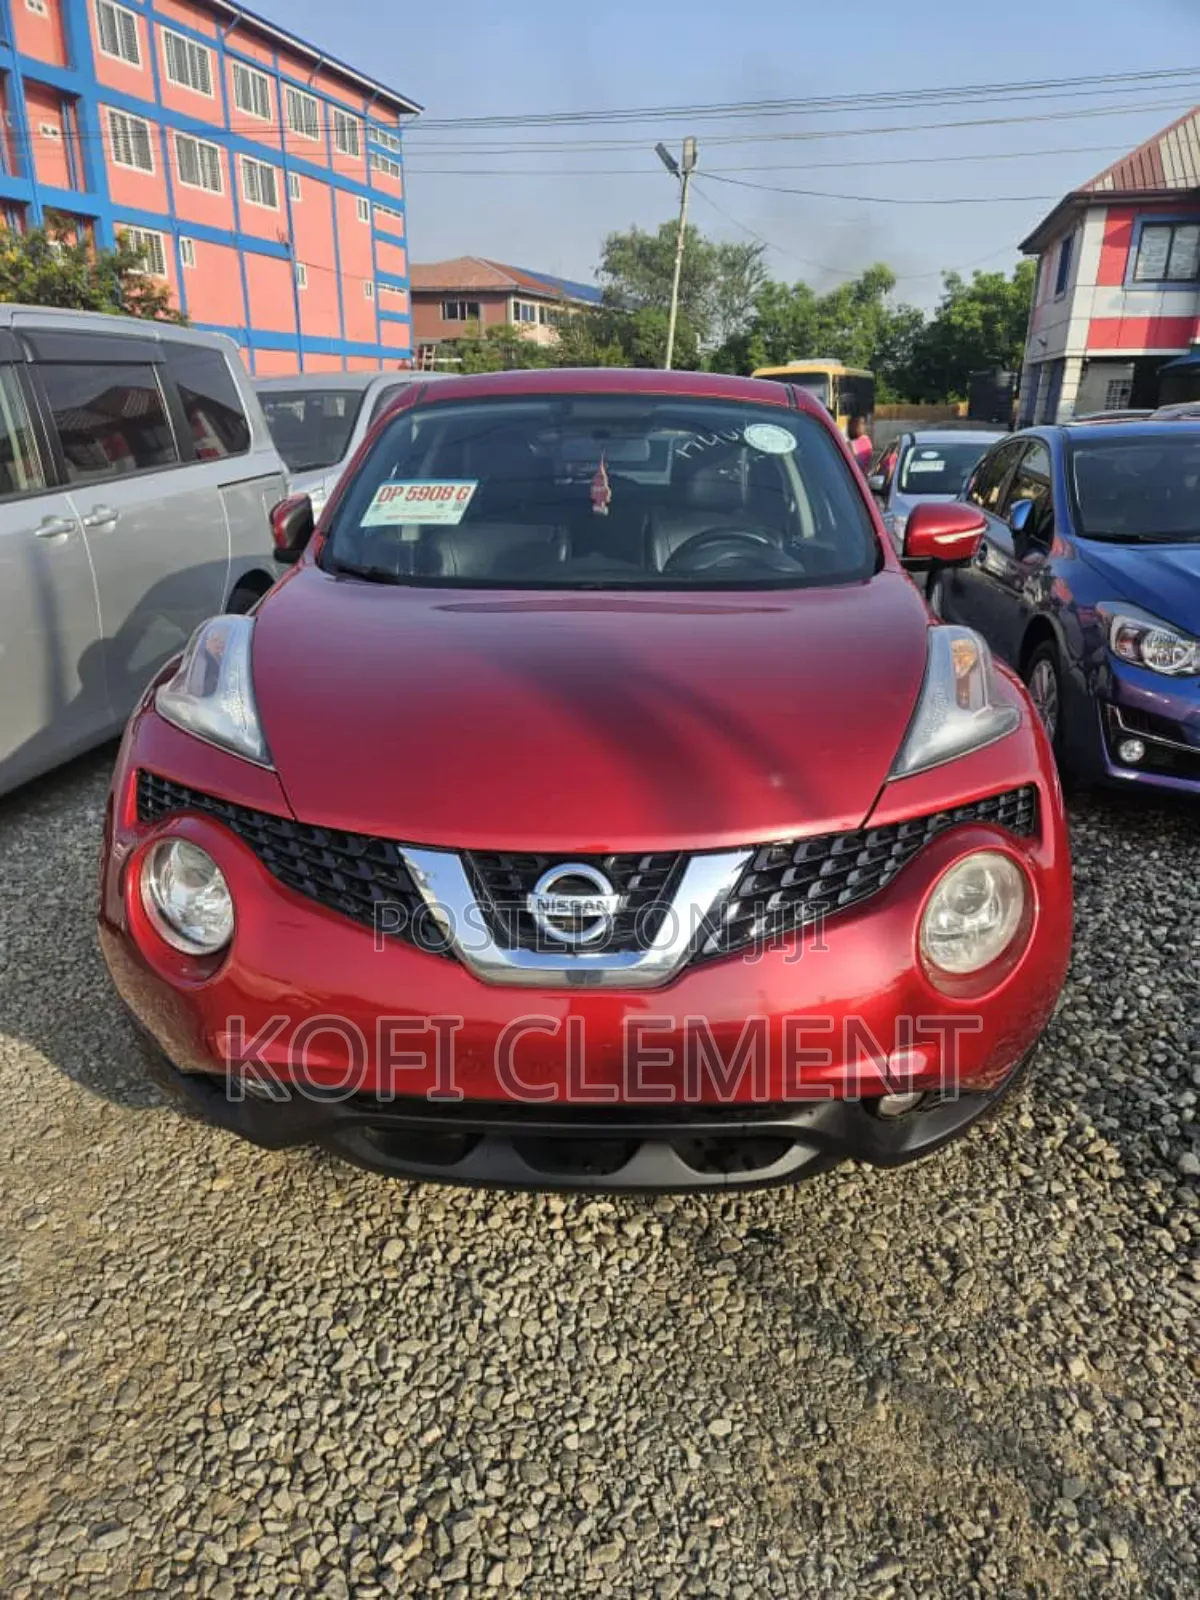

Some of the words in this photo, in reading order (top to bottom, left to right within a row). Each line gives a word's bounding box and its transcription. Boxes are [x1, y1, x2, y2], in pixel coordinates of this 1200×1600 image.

[405, 486, 455, 501] 5908
[457, 486, 471, 501] G
[537, 898, 611, 913] NISSAN
